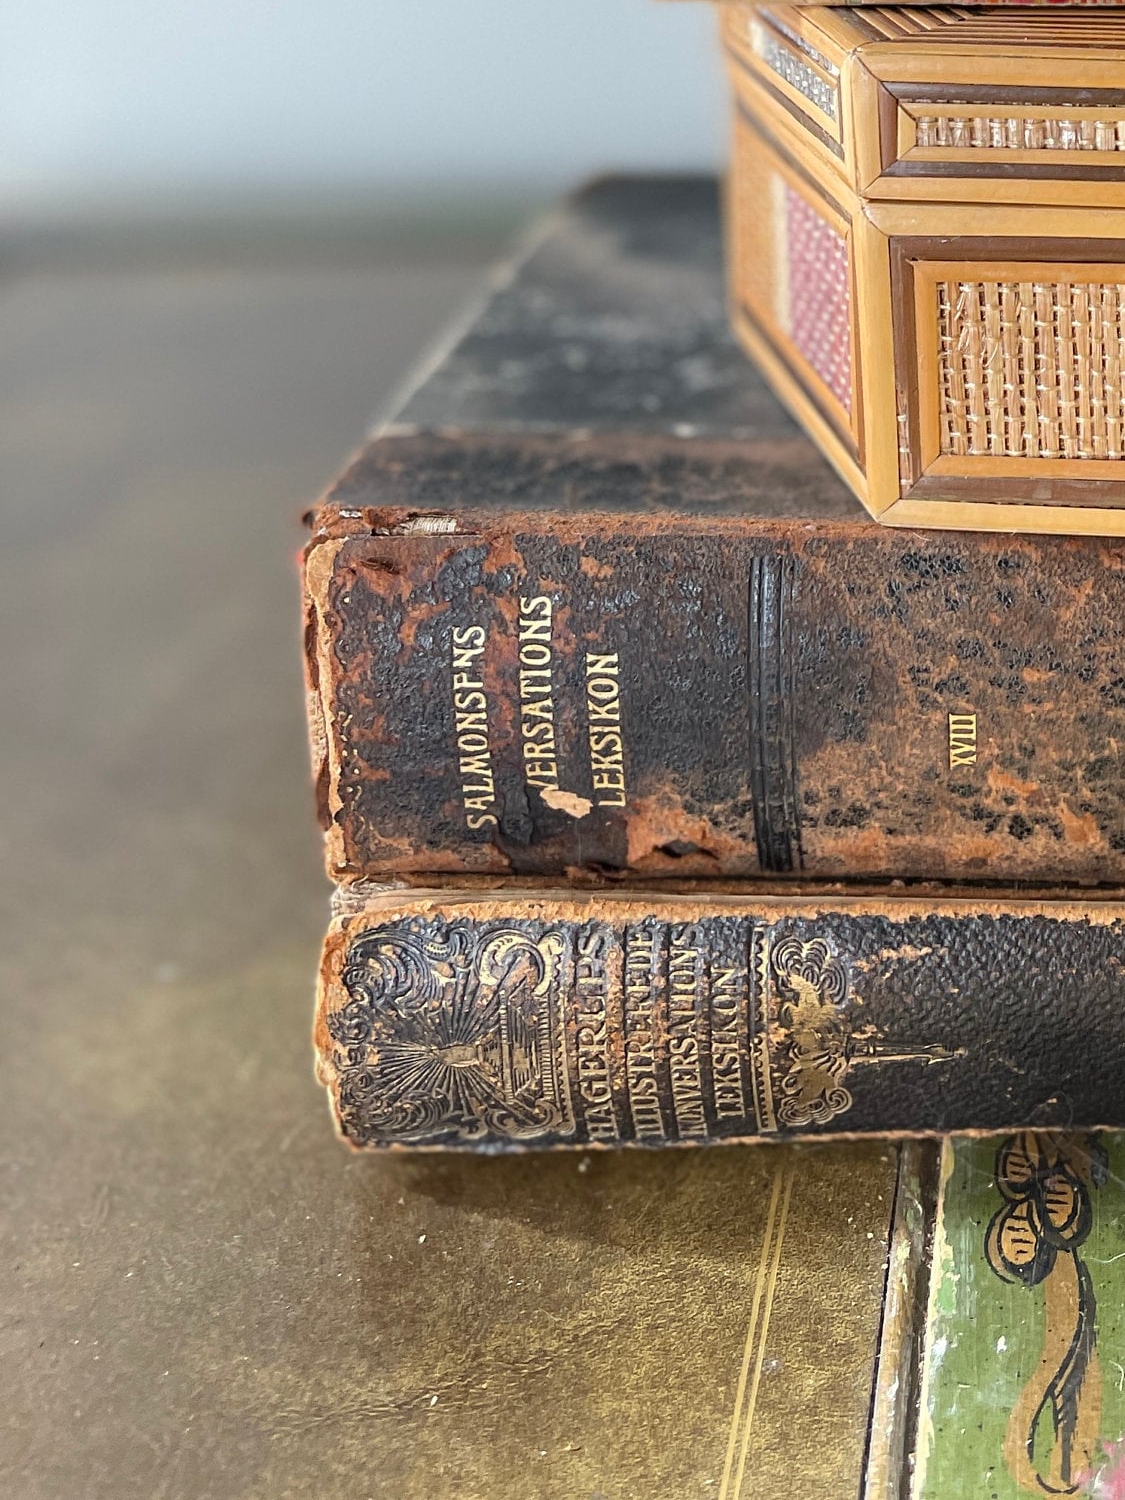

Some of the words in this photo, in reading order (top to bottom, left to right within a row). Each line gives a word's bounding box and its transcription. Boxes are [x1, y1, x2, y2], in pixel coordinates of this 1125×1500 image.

[518, 595, 559, 791] VERSATIONS
[586, 652, 626, 808] LEKSIKON
[948, 713, 977, 770] XVIII
[576, 931, 620, 1140] HAGERUPS
[626, 930, 666, 1139] ILLUSTREREDE
[668, 925, 709, 1138] KONVERSATIONS
[710, 966, 746, 1120] LEKSIKON
